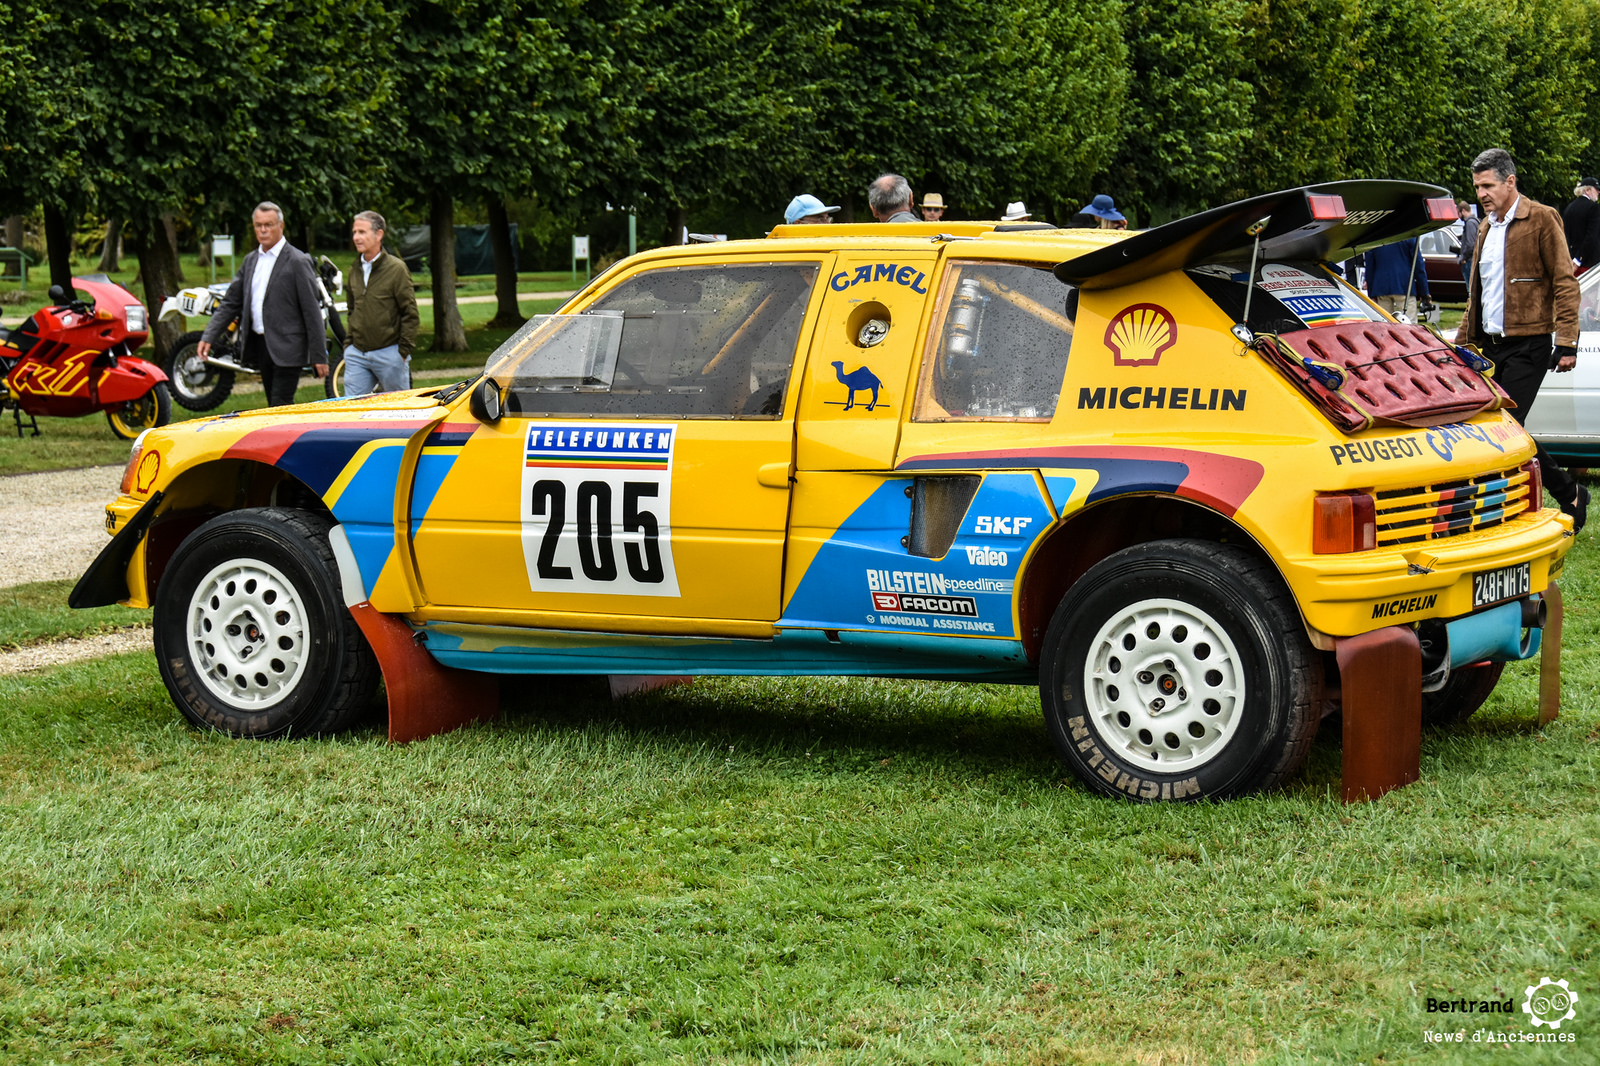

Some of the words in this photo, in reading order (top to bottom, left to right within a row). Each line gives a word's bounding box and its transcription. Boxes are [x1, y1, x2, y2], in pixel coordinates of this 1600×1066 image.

[1344, 210, 1395, 225] UGEOT
[831, 263, 927, 294] CAMEL
[1077, 386, 1247, 411] MICHELIN
[531, 430, 671, 449] TELEFUNKEN
[1329, 437, 1423, 465] PEUGEOT
[532, 479, 665, 584] 205
[975, 516, 1032, 535] SKF
[965, 546, 1008, 567] Valeo
[866, 569, 947, 594] BILSTEIN
[944, 578, 1004, 592] speedline
[1371, 594, 1438, 619] MICHELIN
[880, 615, 929, 627] MONDIAL
[933, 619, 996, 632] ASSISTANCE
[1067, 715, 1201, 800] MICHELIN
